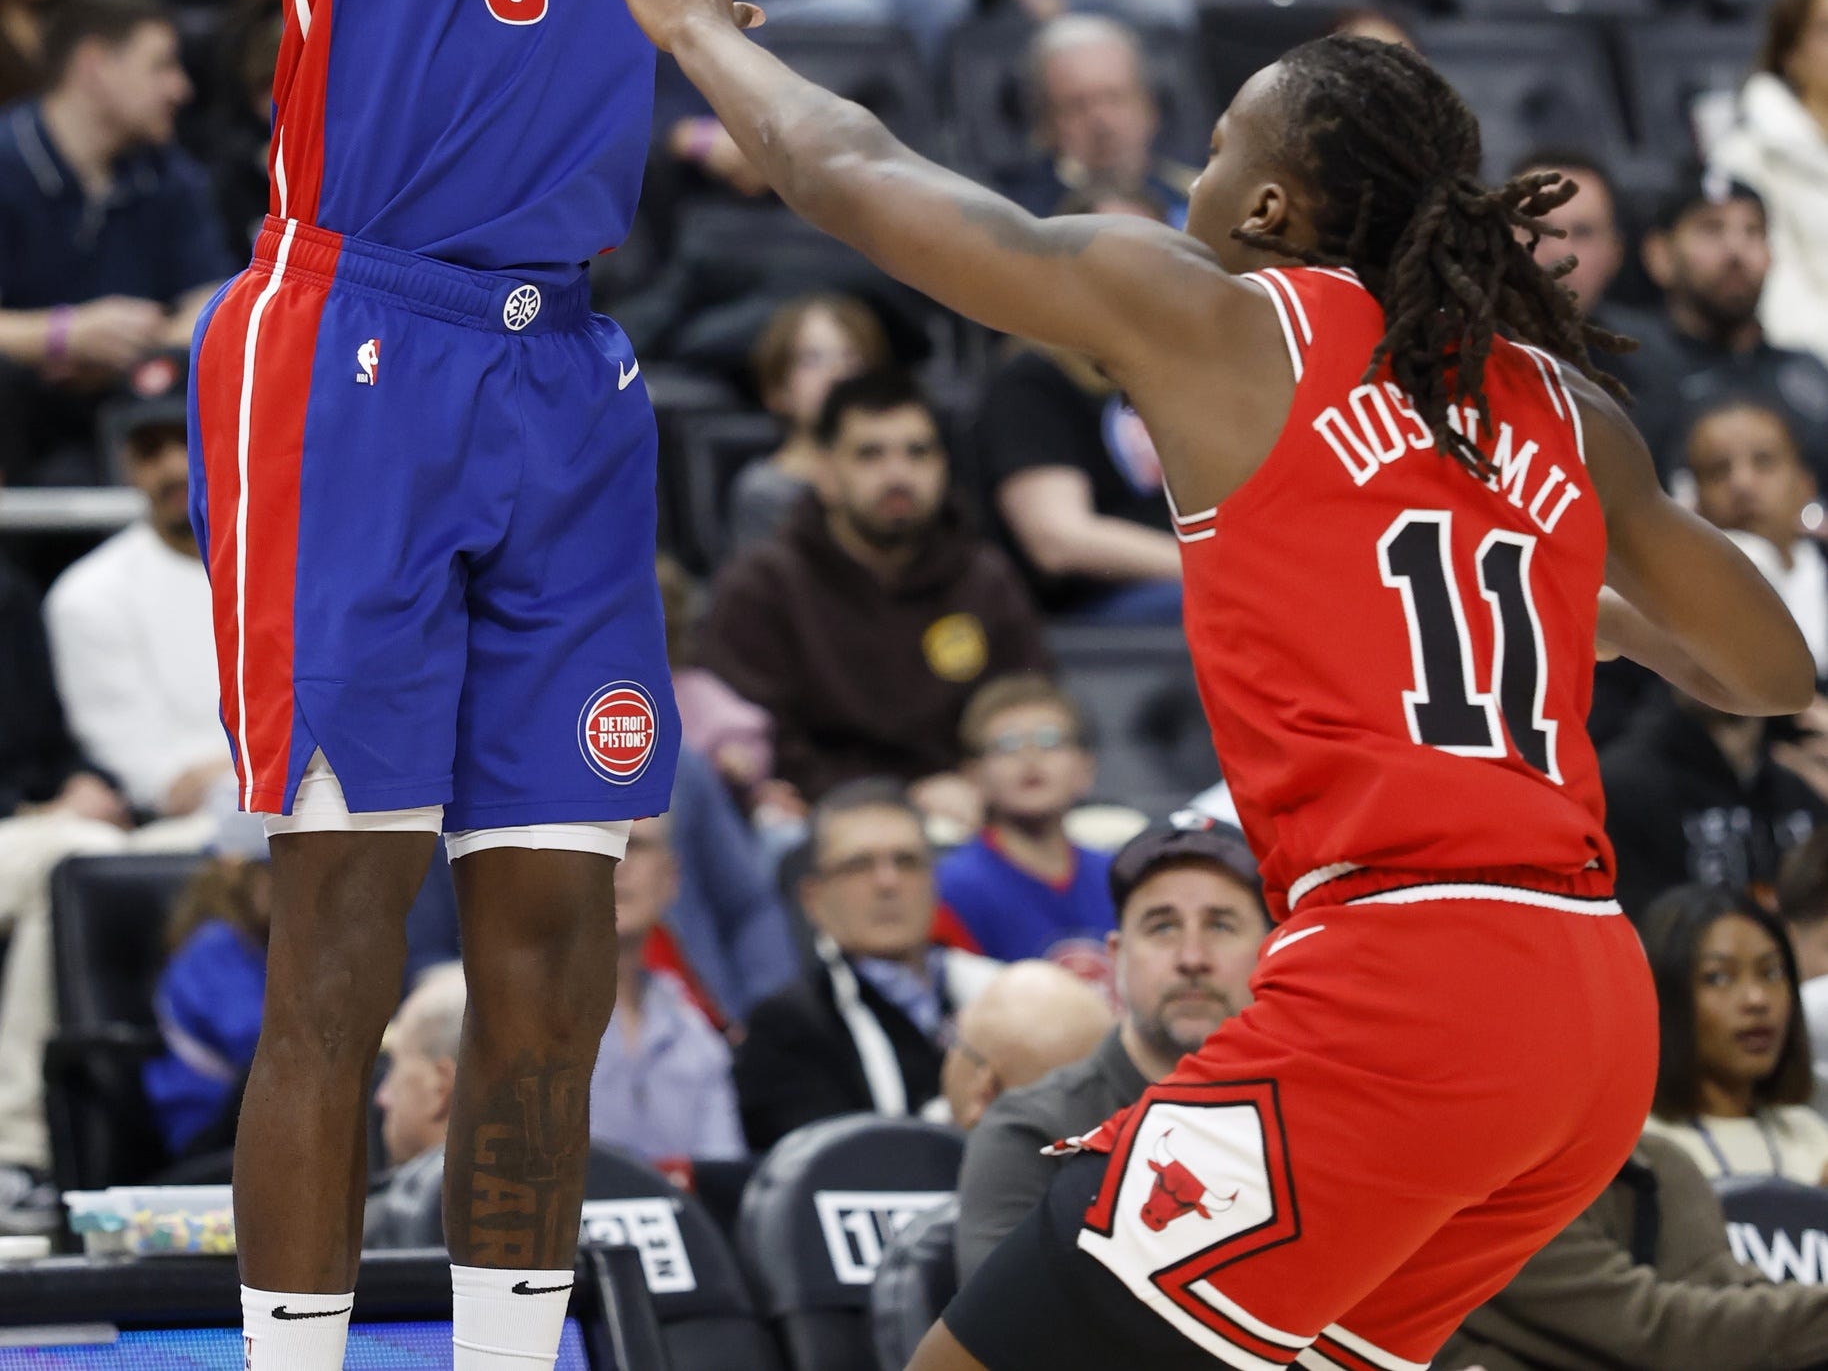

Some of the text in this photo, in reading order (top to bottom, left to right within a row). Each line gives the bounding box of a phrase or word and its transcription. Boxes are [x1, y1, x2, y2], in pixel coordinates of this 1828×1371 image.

[1376, 509, 1564, 786] 11
[598, 716, 647, 731] DETROIT
[598, 732, 647, 748] PISTONS
